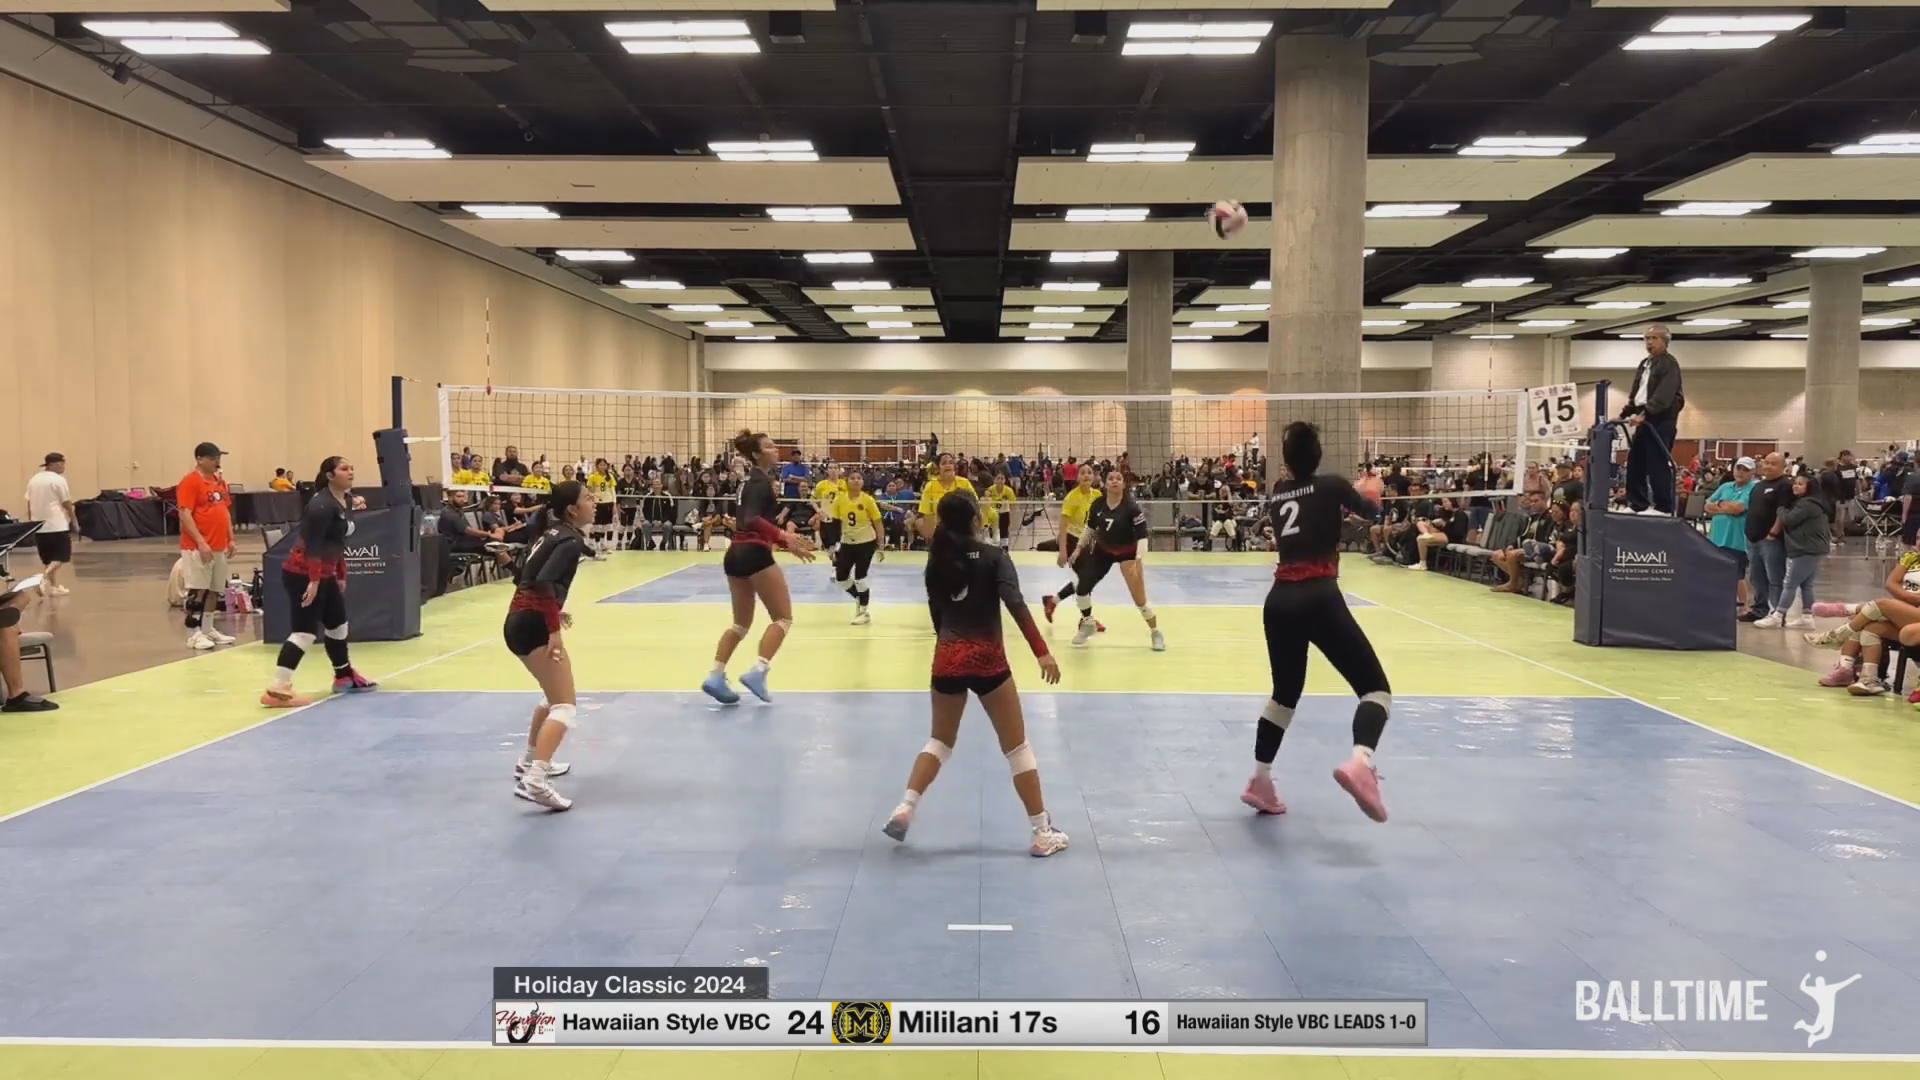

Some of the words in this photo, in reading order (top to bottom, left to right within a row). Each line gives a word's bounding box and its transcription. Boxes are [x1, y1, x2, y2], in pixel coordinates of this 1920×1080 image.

[1537, 395, 1575, 425] 15
[847, 511, 857, 527] 9
[1105, 518, 1115, 532] 7
[1279, 500, 1300, 538] 2
